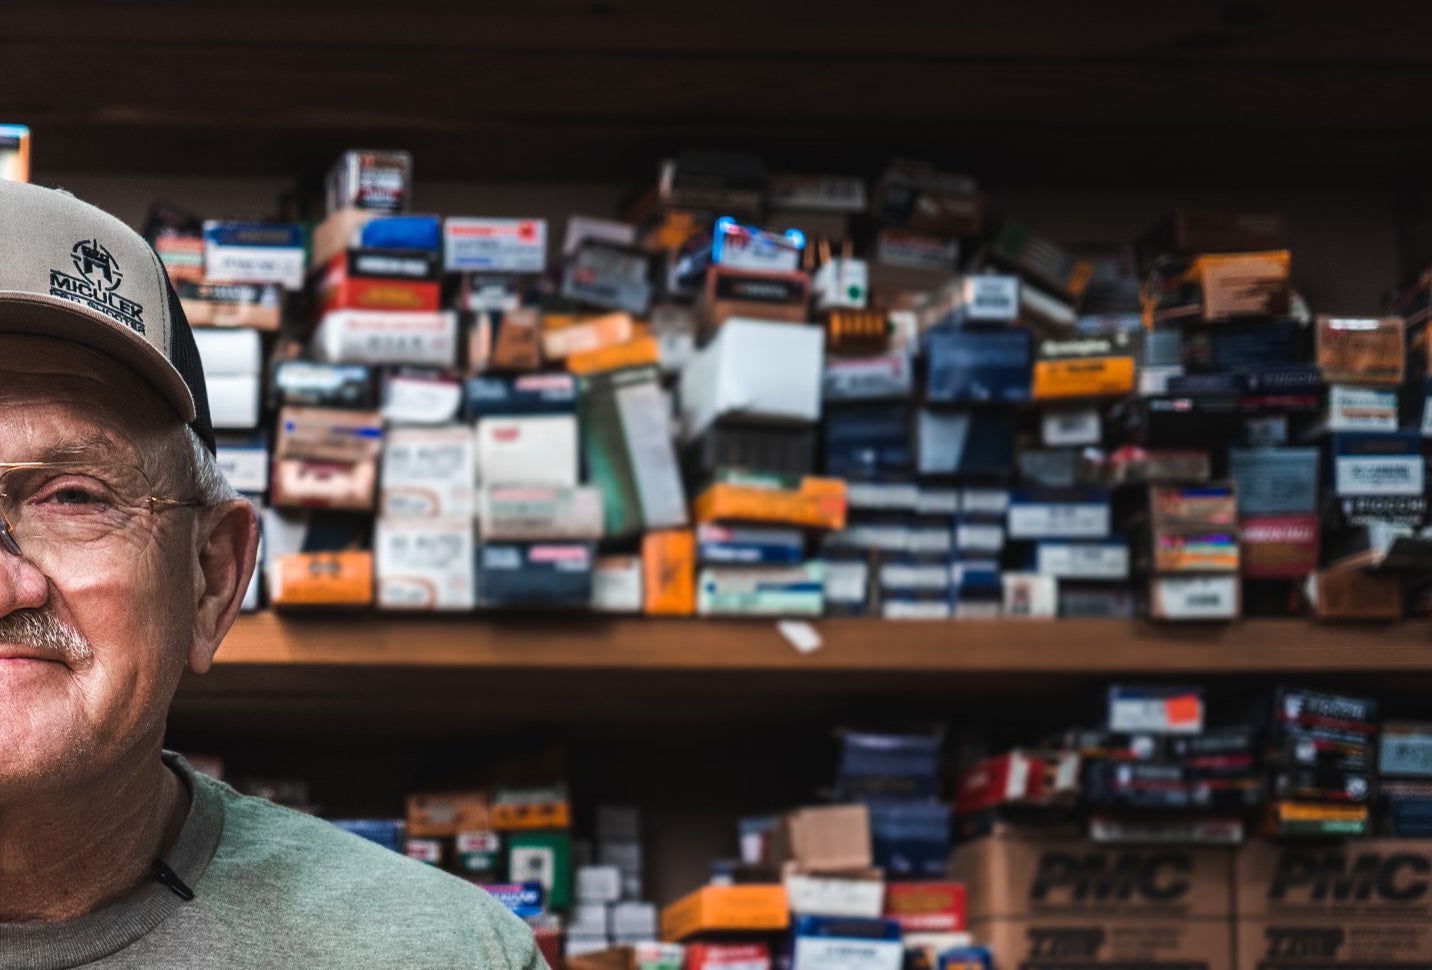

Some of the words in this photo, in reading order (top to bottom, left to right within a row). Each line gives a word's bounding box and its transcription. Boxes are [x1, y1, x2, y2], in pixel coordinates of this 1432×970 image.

[49, 272, 144, 322] MICULEK
[1029, 851, 1194, 900] PMC
[1268, 851, 1432, 901] PMC
